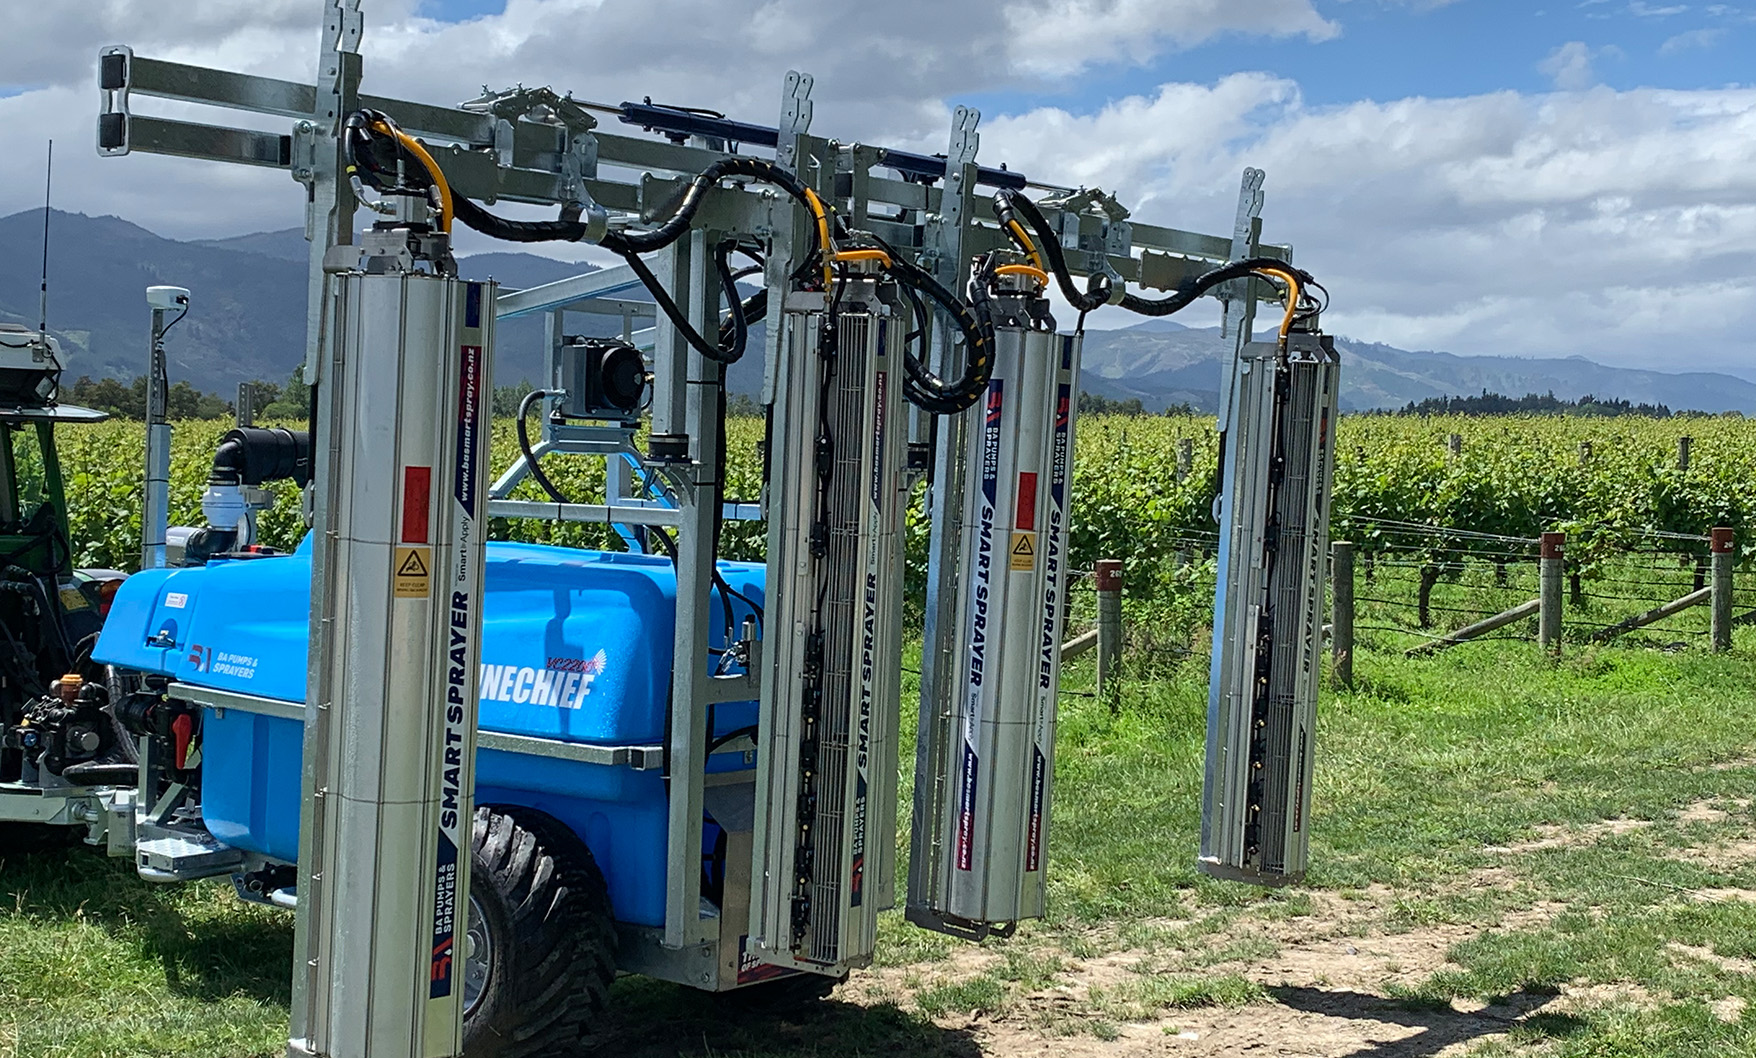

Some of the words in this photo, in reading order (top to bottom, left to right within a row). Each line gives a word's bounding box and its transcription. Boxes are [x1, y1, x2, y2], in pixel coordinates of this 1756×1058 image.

[461, 348, 475, 501] www.basmartspray.co.nz
[873, 373, 883, 499] www.basmartspray.co.nz
[984, 427, 992, 479] SPRAYERS
[992, 427, 998, 440] BA
[1060, 432, 1066, 444] BA
[977, 505, 993, 584] SMART
[1045, 509, 1061, 588] SMART
[1309, 517, 1320, 584] SMART
[217, 652, 227, 662] BA
[228, 653, 253, 666] PUMPS
[252, 658, 258, 667] &
[447, 590, 468, 724] SPRAYER
[862, 572, 876, 683] SPRAYER
[970, 585, 988, 686] SPRAYER
[1039, 588, 1056, 689] SPRAYER
[1304, 588, 1315, 673] SPRAYER
[213, 662, 255, 679] SPRAYERS
[480, 664, 595, 709] NECHIEF
[857, 690, 871, 769] SMART
[441, 728, 462, 829] SMART
[436, 876, 446, 916] PUMPS
[438, 864, 446, 873] &
[444, 863, 455, 932] SPRAYERS
[435, 918, 443, 934] BA
